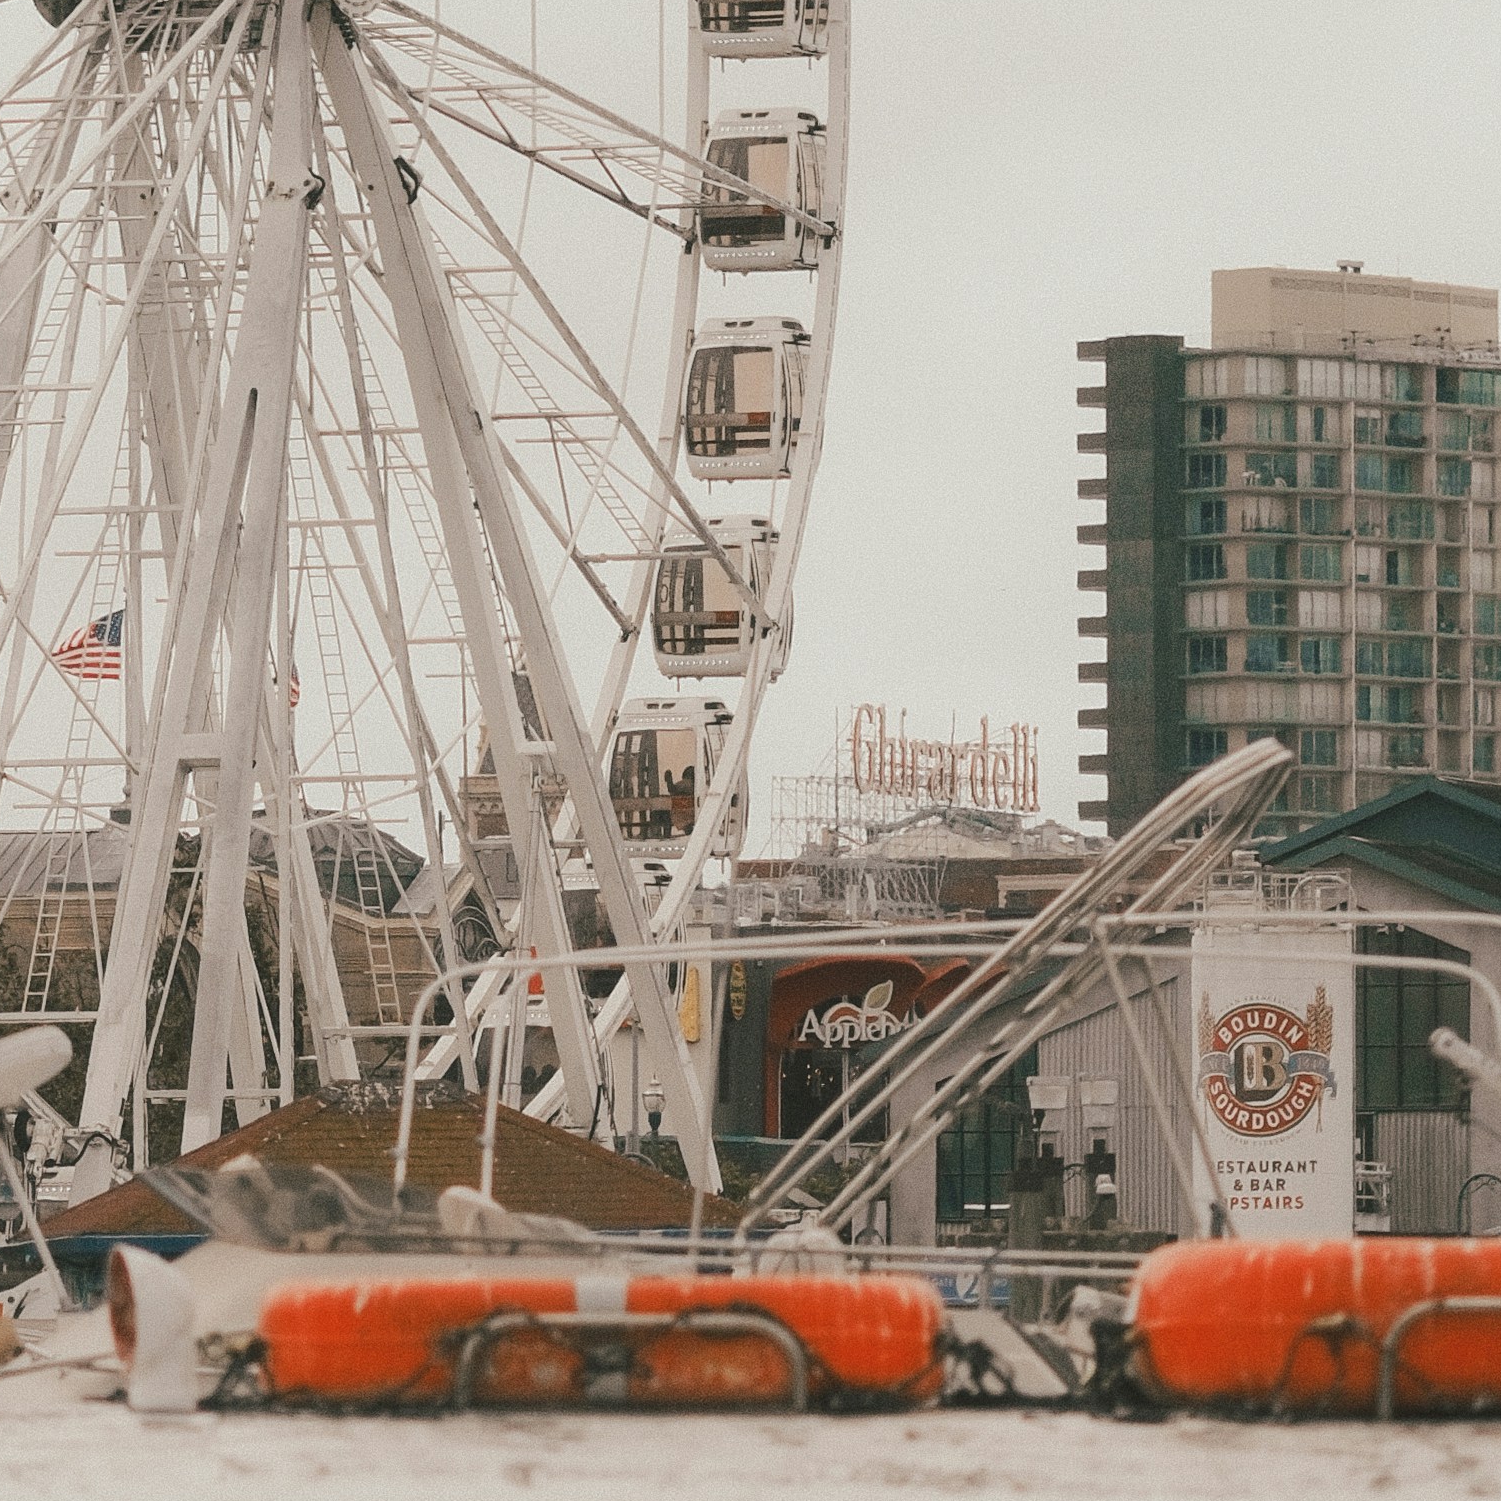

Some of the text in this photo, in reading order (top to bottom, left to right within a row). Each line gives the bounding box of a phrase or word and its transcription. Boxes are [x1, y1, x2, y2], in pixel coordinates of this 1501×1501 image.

[852, 702, 1041, 813] Ghirardelli
[1218, 1011, 1303, 1044] BOUDIN
[1210, 1081, 1314, 1130] SOURDOUGH
[1217, 1161, 1318, 1174] ESTAURANT
[1233, 1179, 1286, 1191] & BAR
[1229, 1196, 1304, 1210] PSTAIRS
